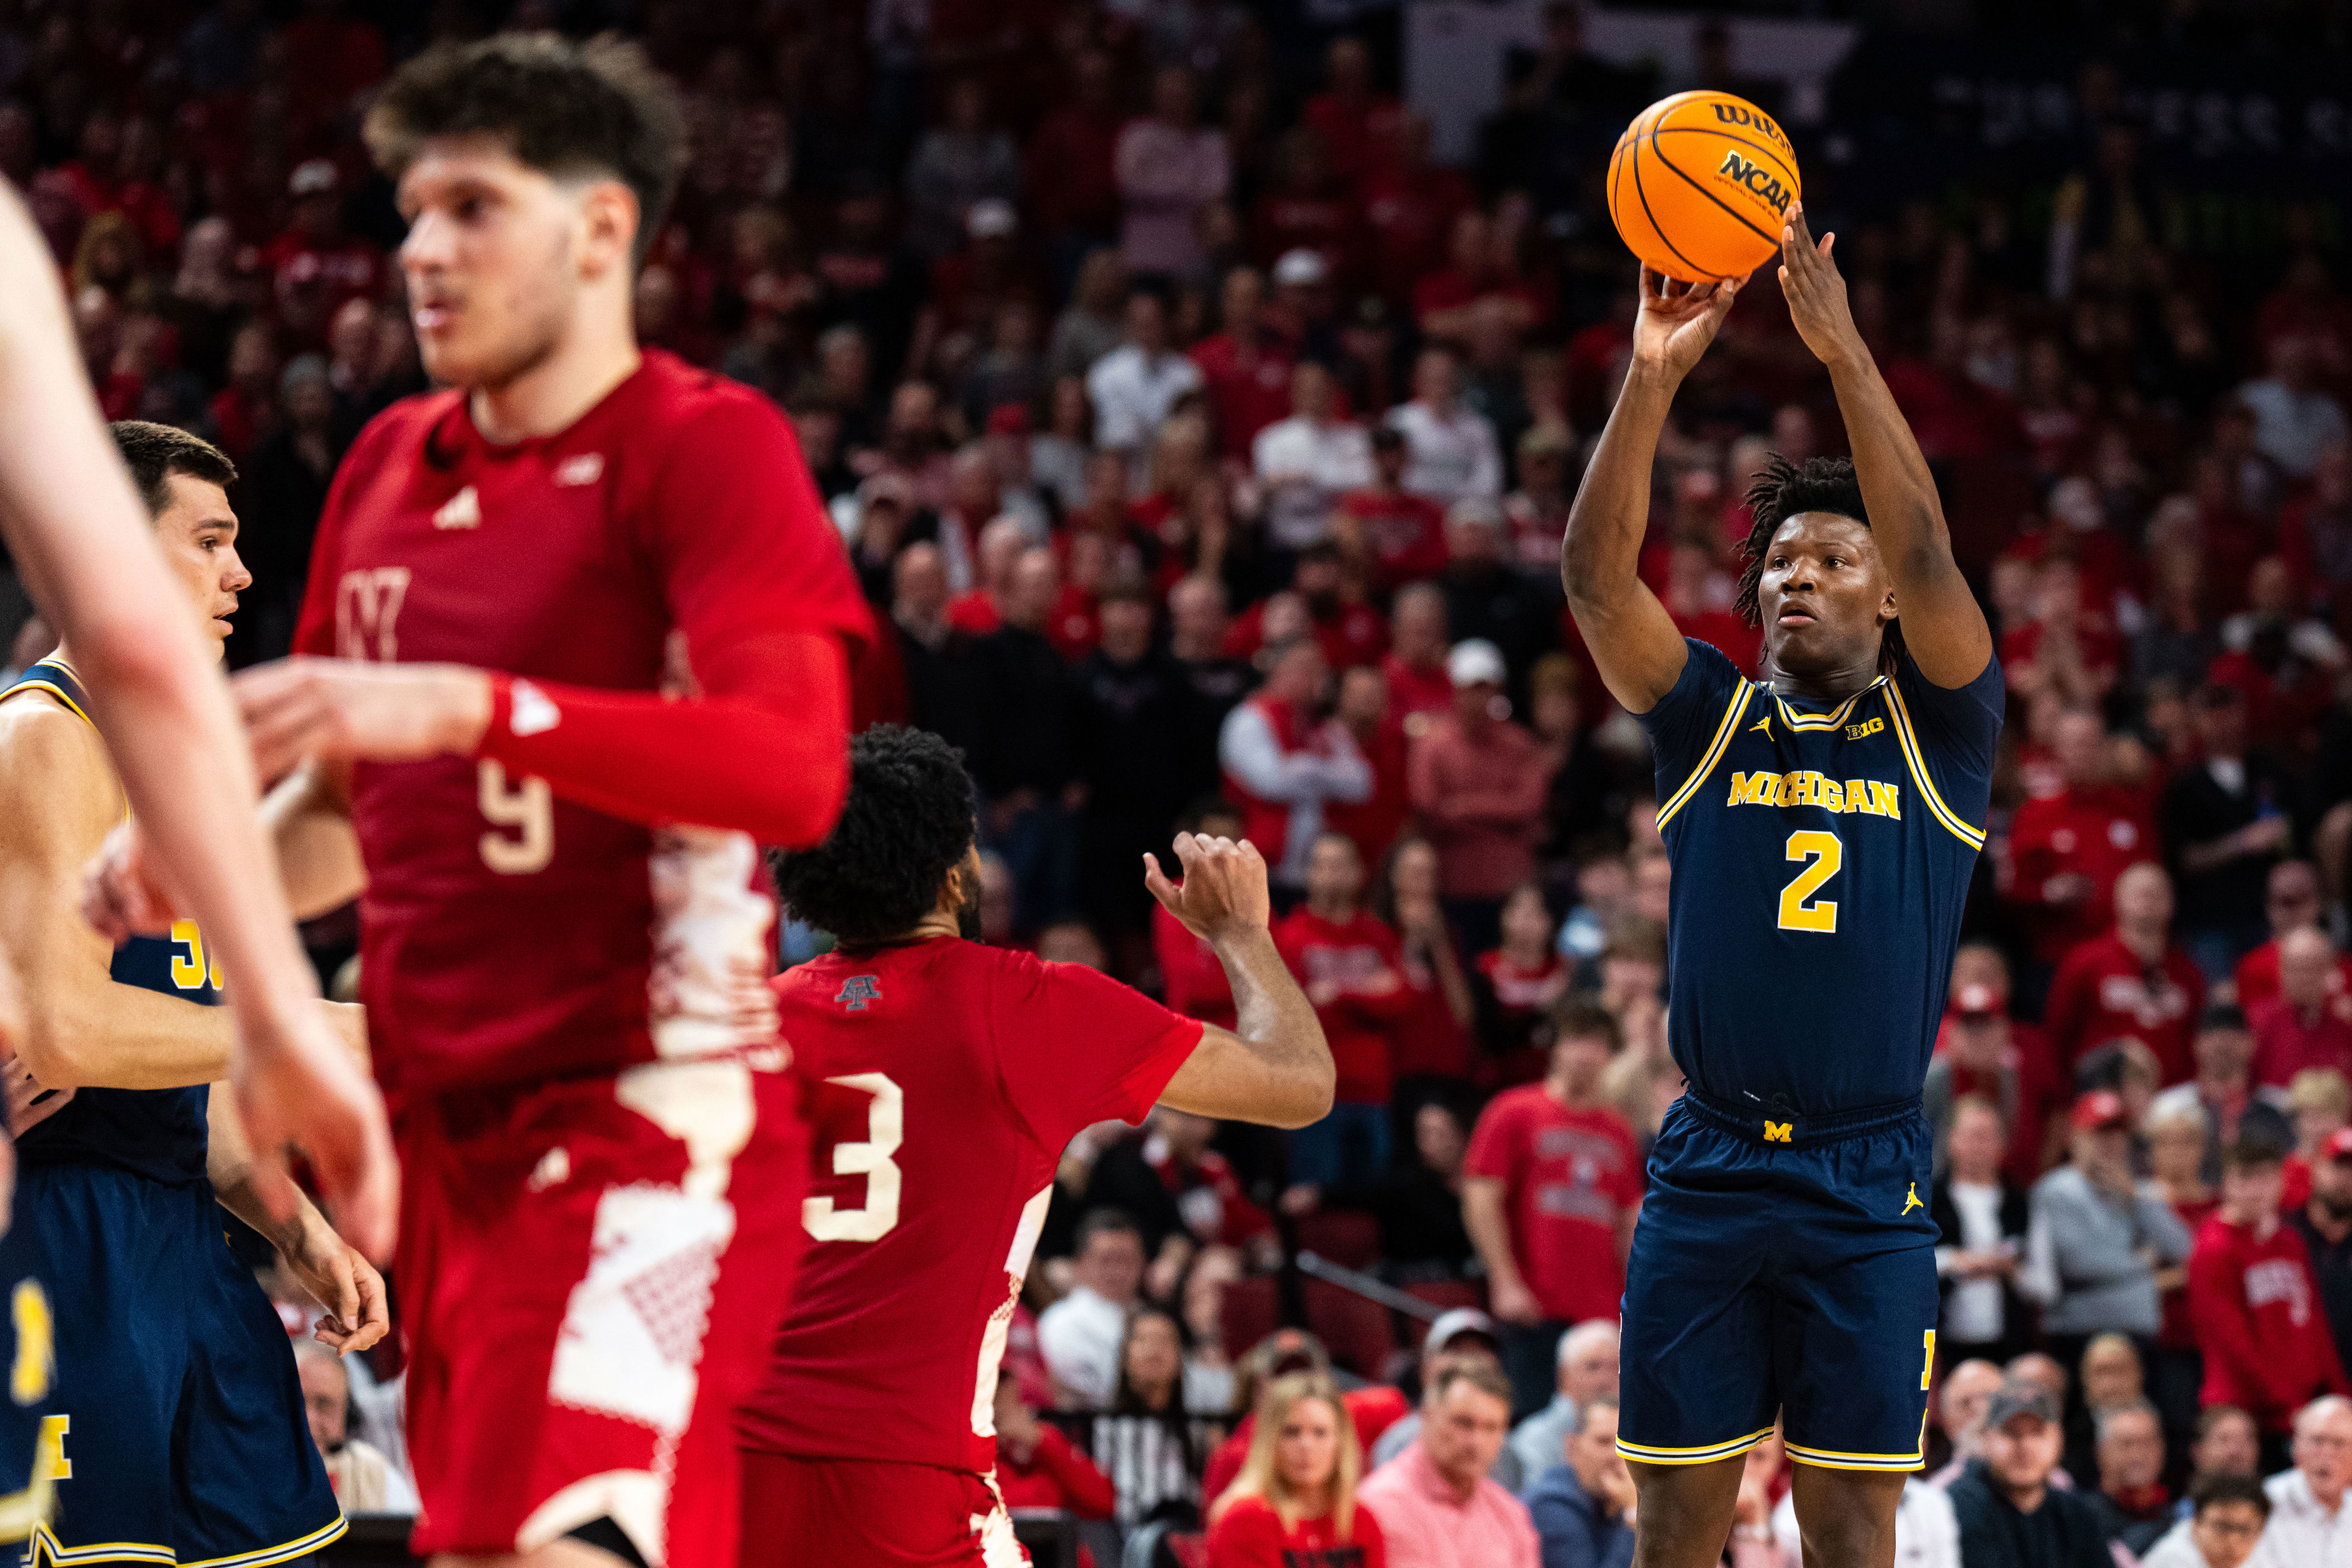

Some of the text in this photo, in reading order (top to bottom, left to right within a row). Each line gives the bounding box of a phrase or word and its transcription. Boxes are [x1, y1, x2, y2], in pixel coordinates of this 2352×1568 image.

[1718, 149, 1792, 218] NCAA
[1727, 770, 1901, 821] MICHIGAN
[1777, 830, 1843, 933] 2
[801, 1070, 904, 1243] 3
[1763, 1120, 1793, 1143] M
